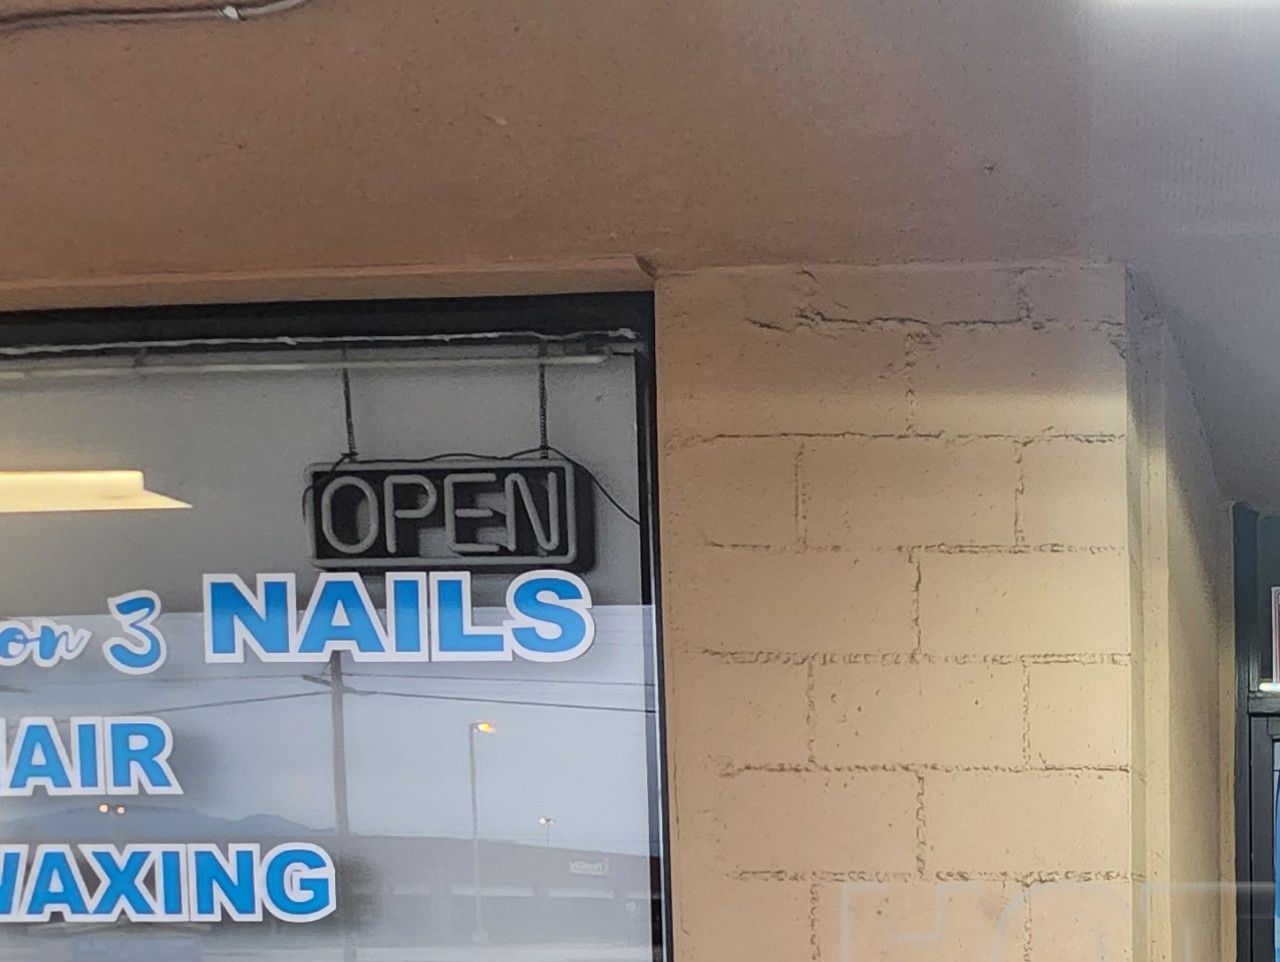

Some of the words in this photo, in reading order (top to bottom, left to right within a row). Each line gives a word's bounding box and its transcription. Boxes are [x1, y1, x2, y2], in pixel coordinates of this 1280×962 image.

[321, 472, 559, 556] OPEN
[103, 590, 167, 675] 3
[202, 570, 595, 664] NAILS
[0, 716, 184, 796] AIR
